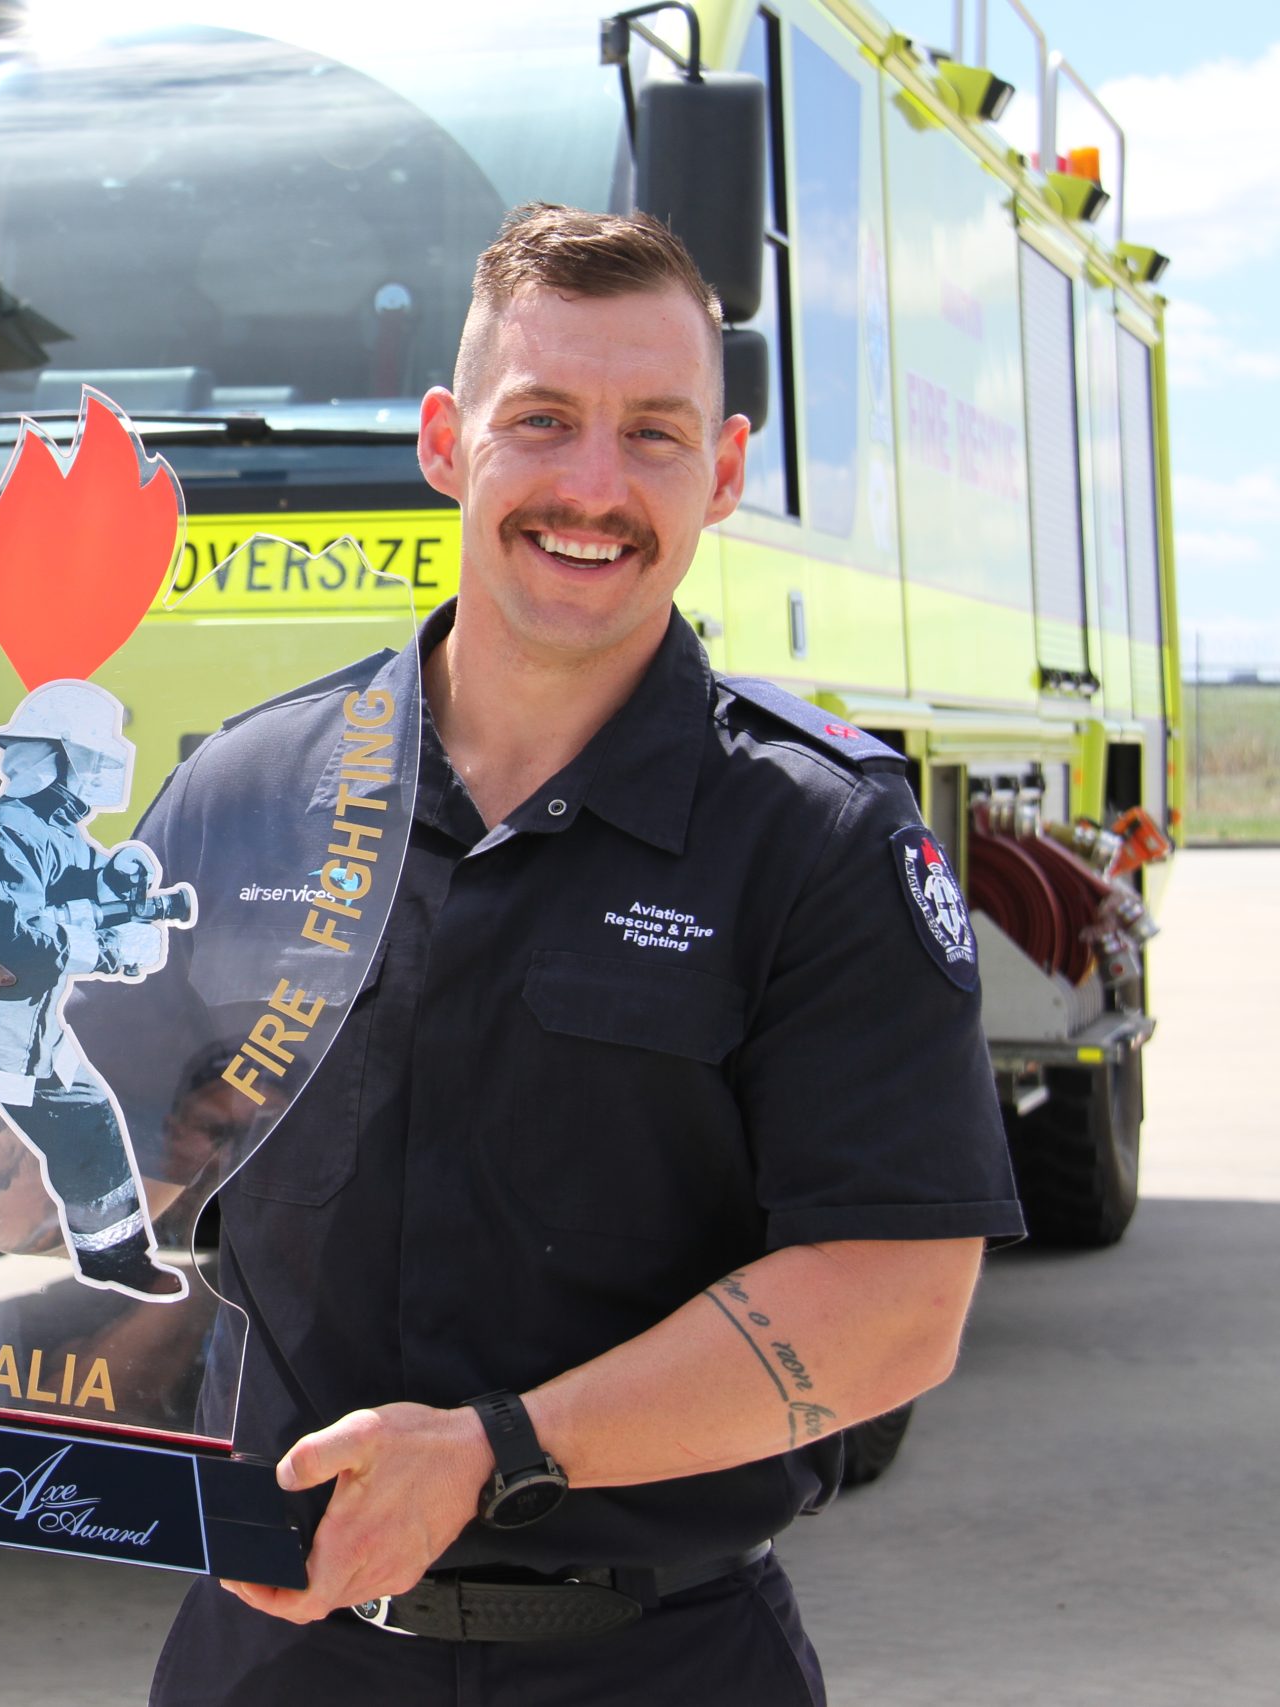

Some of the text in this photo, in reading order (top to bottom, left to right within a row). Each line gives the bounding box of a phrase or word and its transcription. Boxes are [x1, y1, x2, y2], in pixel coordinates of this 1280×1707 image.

[173, 537, 441, 592] OVERSIZE
[222, 689, 395, 1106] FIRE FIGHTING
[239, 883, 336, 903] airservices
[905, 858, 928, 909] AVIATION
[604, 912, 714, 938] Rescue & Fire
[629, 901, 695, 924] Aviation
[623, 929, 689, 952] Fighting
[37, 1507, 160, 1547] Award
